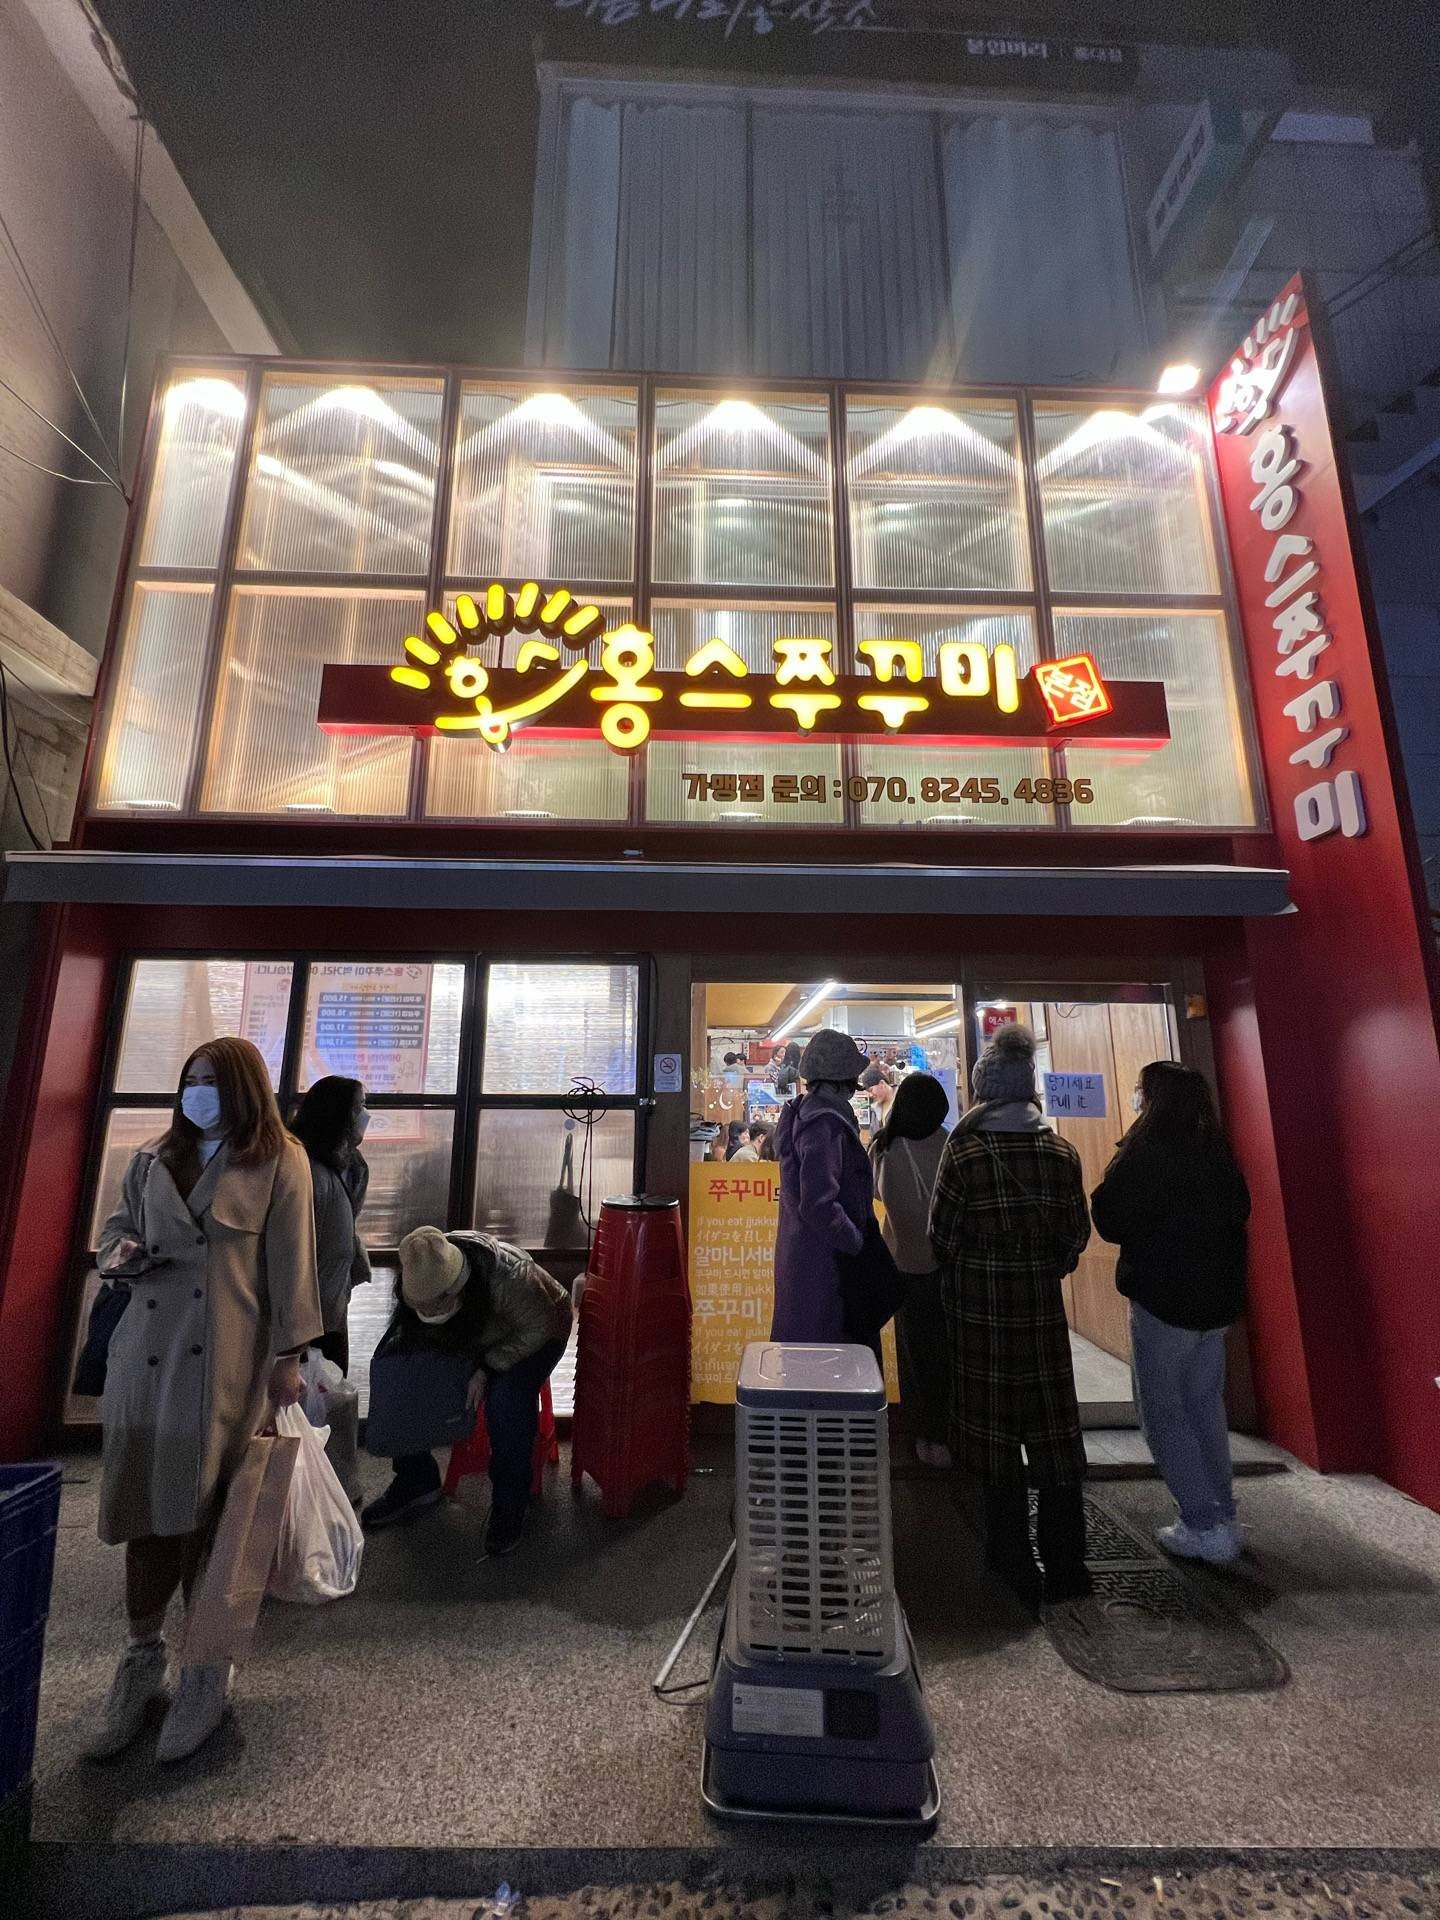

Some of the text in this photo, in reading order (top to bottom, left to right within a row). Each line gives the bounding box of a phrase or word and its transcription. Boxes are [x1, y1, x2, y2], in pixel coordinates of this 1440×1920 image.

[1250, 424, 1365, 841] 홍스쭈꾸미
[589, 623, 1020, 749] 홍스쭈꾸미
[682, 773, 765, 801] 가맹점
[1048, 1074, 1096, 1091] 당기세요
[1077, 1094, 1088, 1109] it
[707, 1217, 725, 1229] you
[727, 1216, 743, 1227] eat
[692, 1298, 763, 1326] 쭈꾸미
